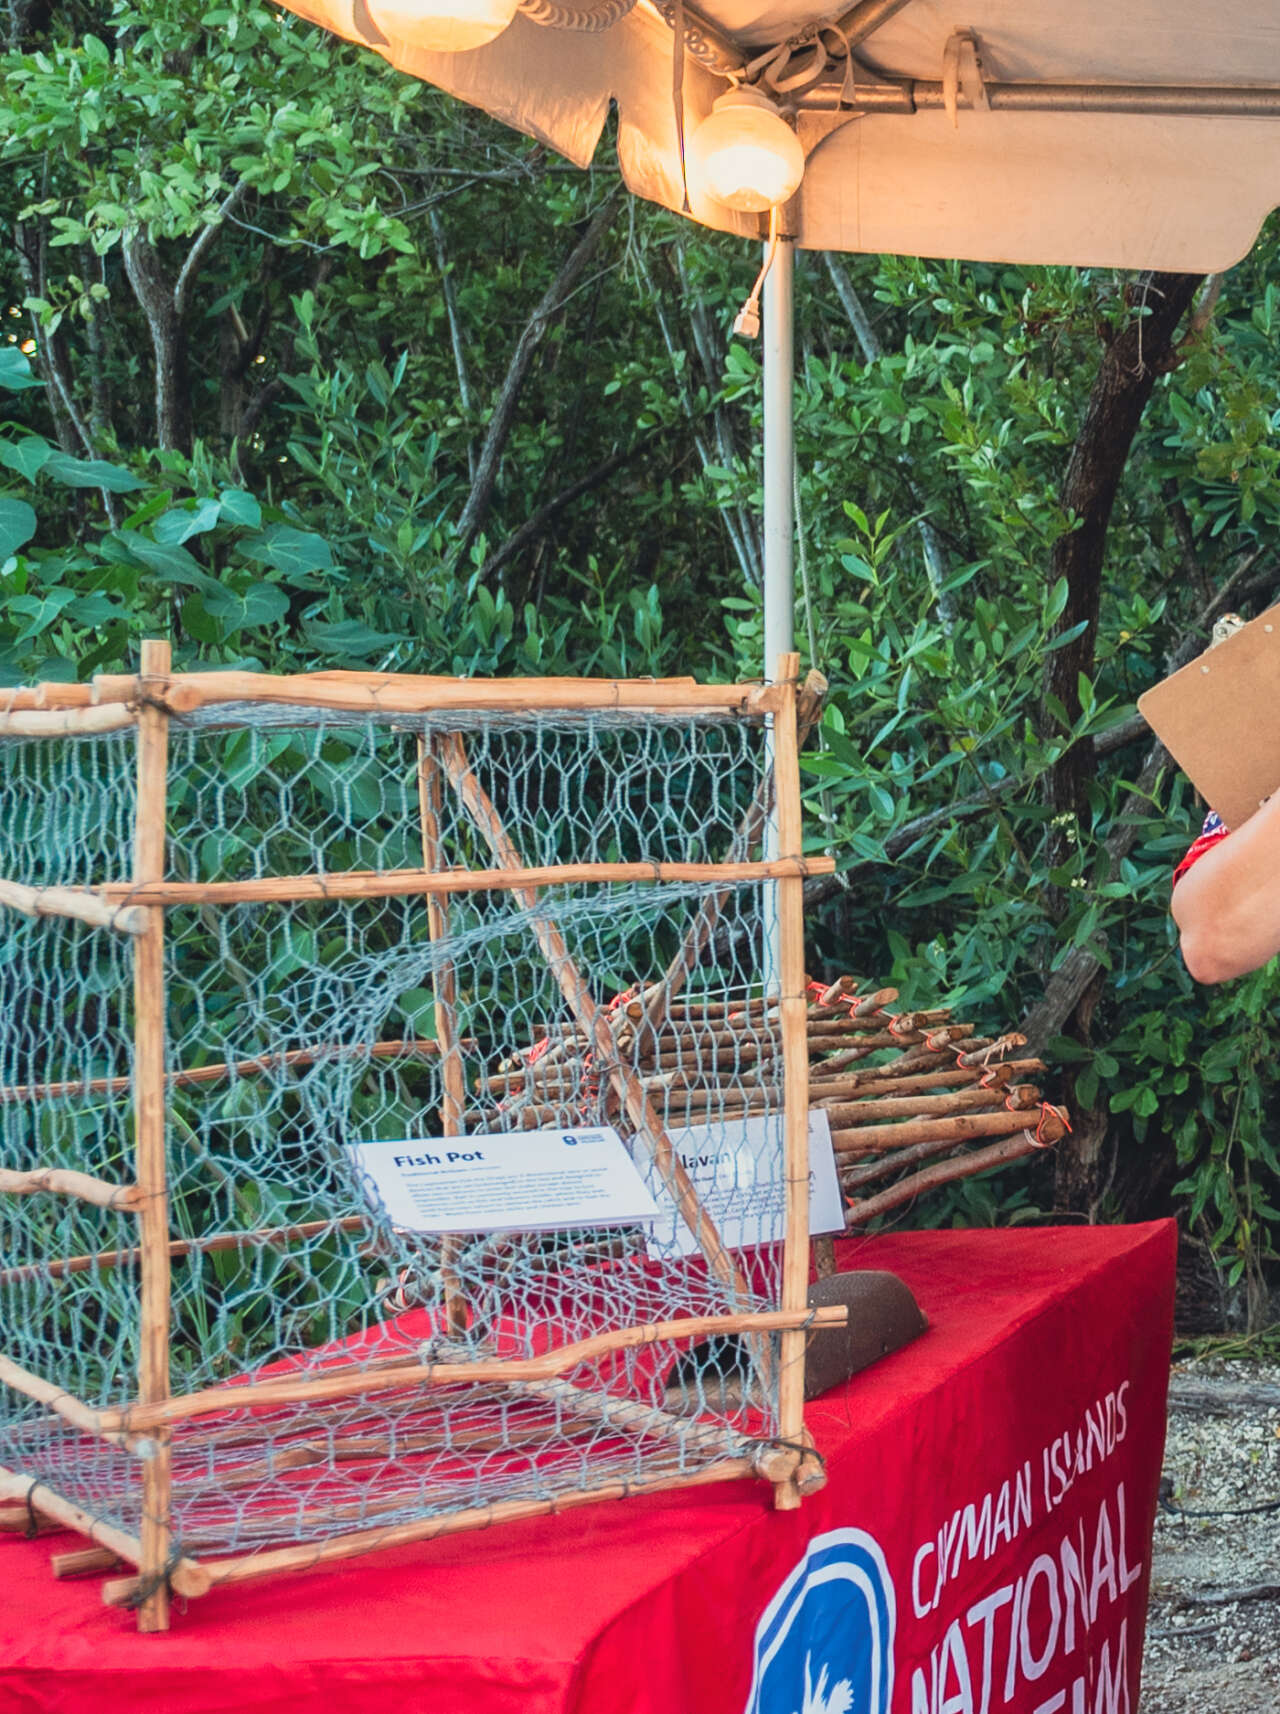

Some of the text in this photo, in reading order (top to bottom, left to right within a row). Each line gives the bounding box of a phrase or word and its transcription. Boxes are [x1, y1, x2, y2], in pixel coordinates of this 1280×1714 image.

[393, 1150, 485, 1167] Fish Pot
[682, 1152, 731, 1169] lavan
